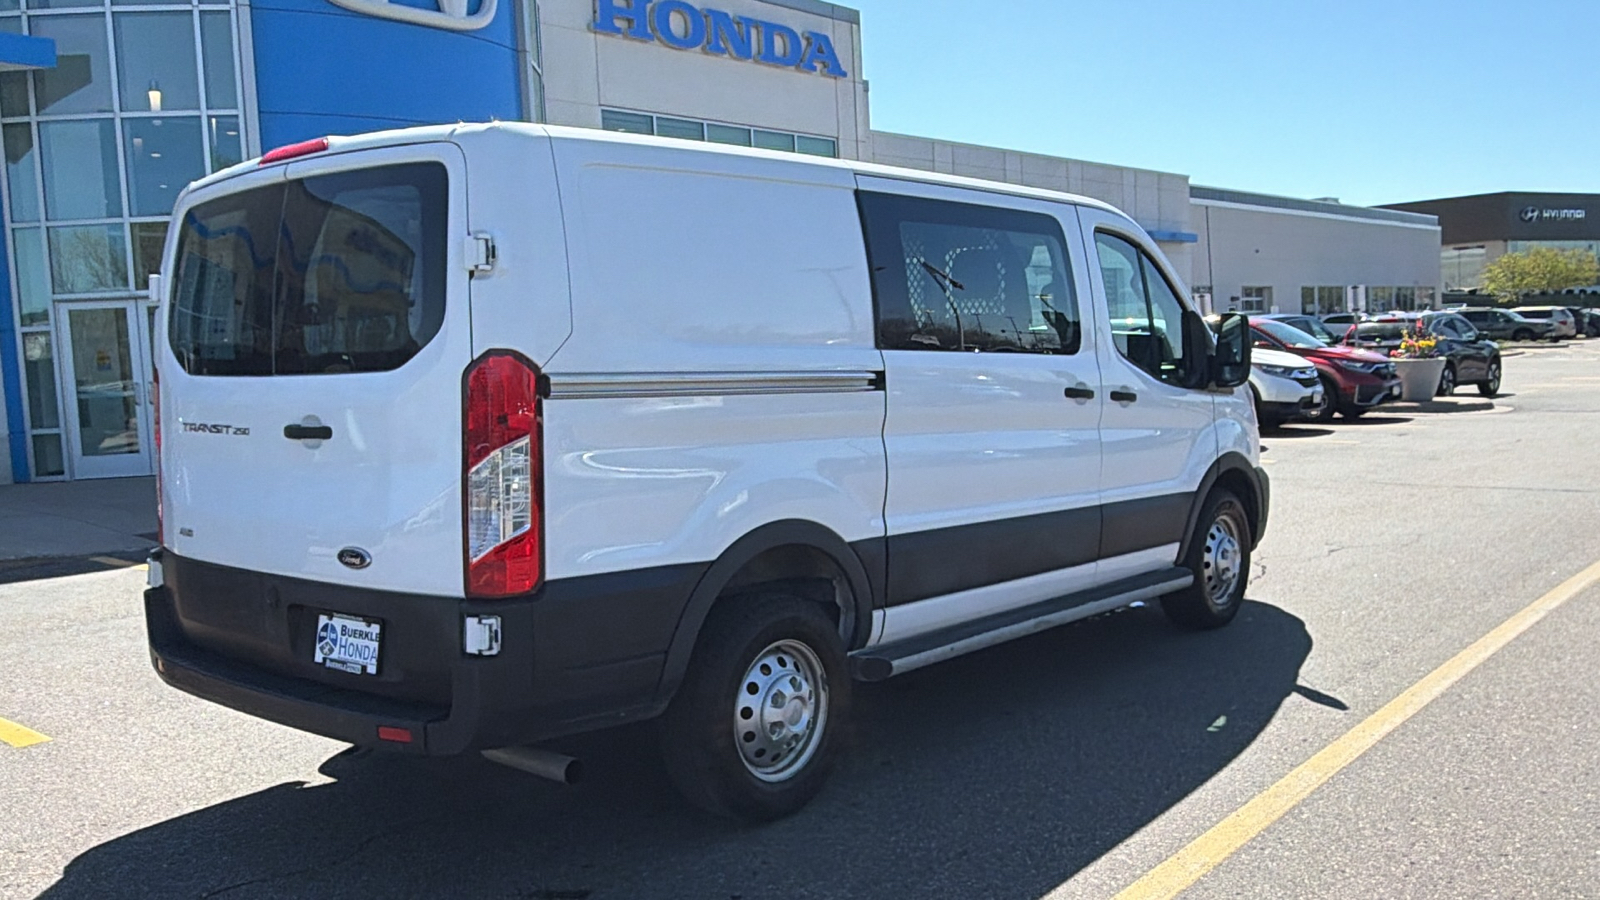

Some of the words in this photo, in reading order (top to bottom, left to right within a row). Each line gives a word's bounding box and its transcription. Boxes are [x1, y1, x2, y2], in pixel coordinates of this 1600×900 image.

[590, 0, 848, 79] HONDA
[1542, 209, 1586, 219] HYUNDAI
[182, 422, 232, 435] TRANSIT
[233, 427, 250, 436] 250
[338, 637, 377, 661] HONDA
